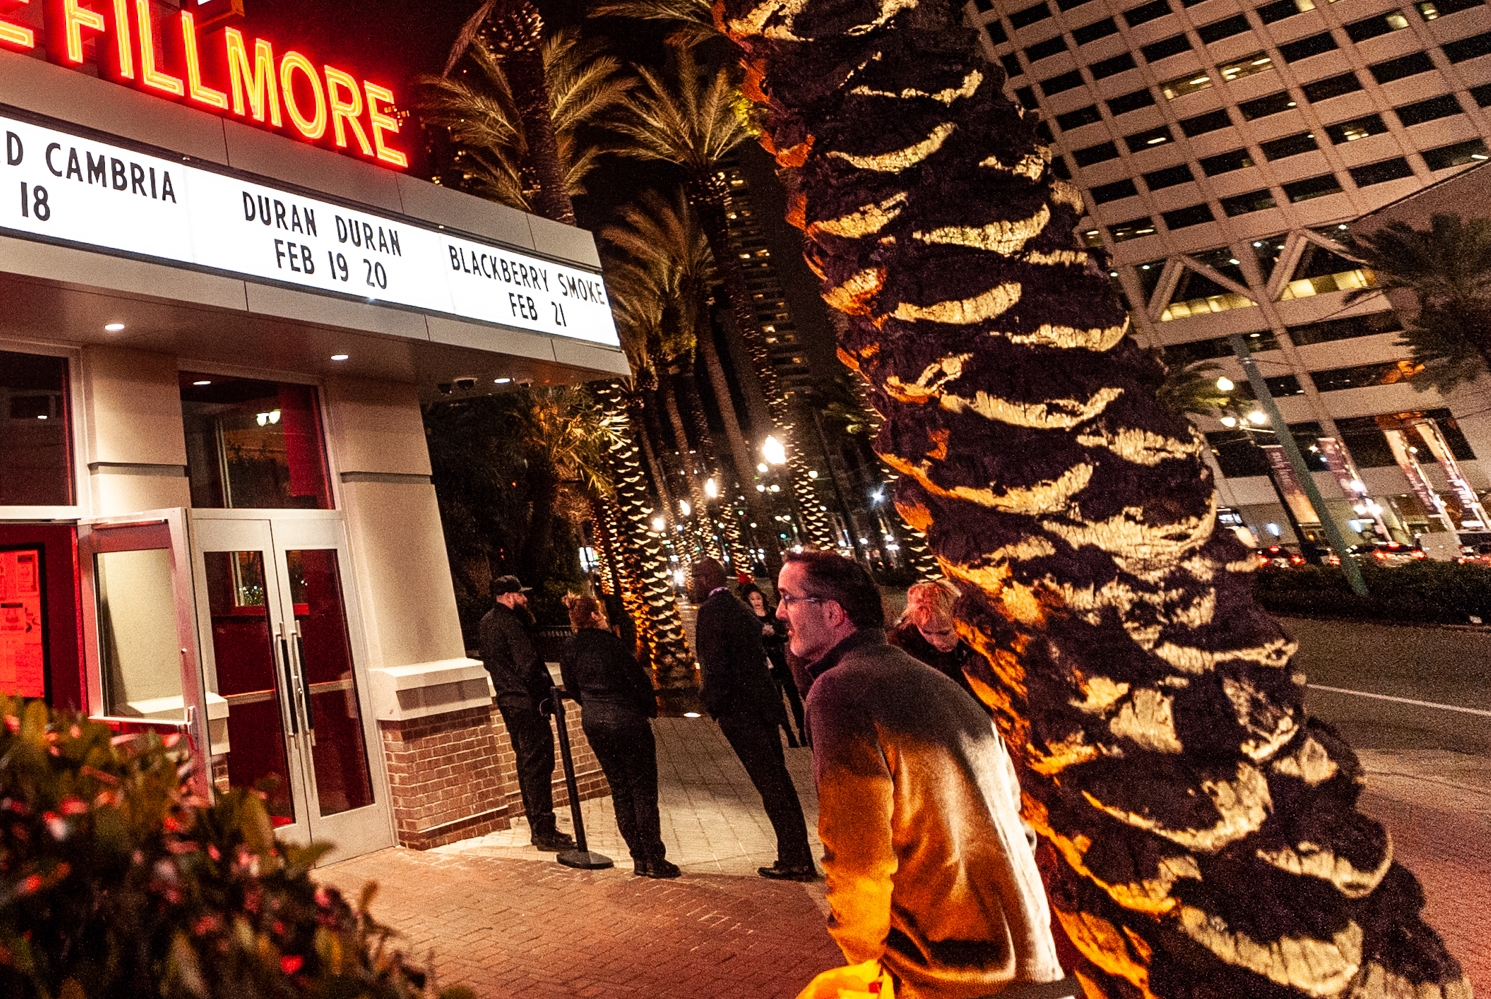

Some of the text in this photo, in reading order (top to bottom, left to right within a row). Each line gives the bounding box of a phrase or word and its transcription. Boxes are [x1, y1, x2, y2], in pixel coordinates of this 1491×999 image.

[46, 143, 177, 203] CAMBRIA
[20, 181, 51, 221] 18
[242, 191, 401, 256] DURAN DURAN
[274, 238, 387, 289] FEB 19 20
[448, 245, 605, 305] BLACKBERRY SMOKE
[508, 292, 567, 327] FEB 21
